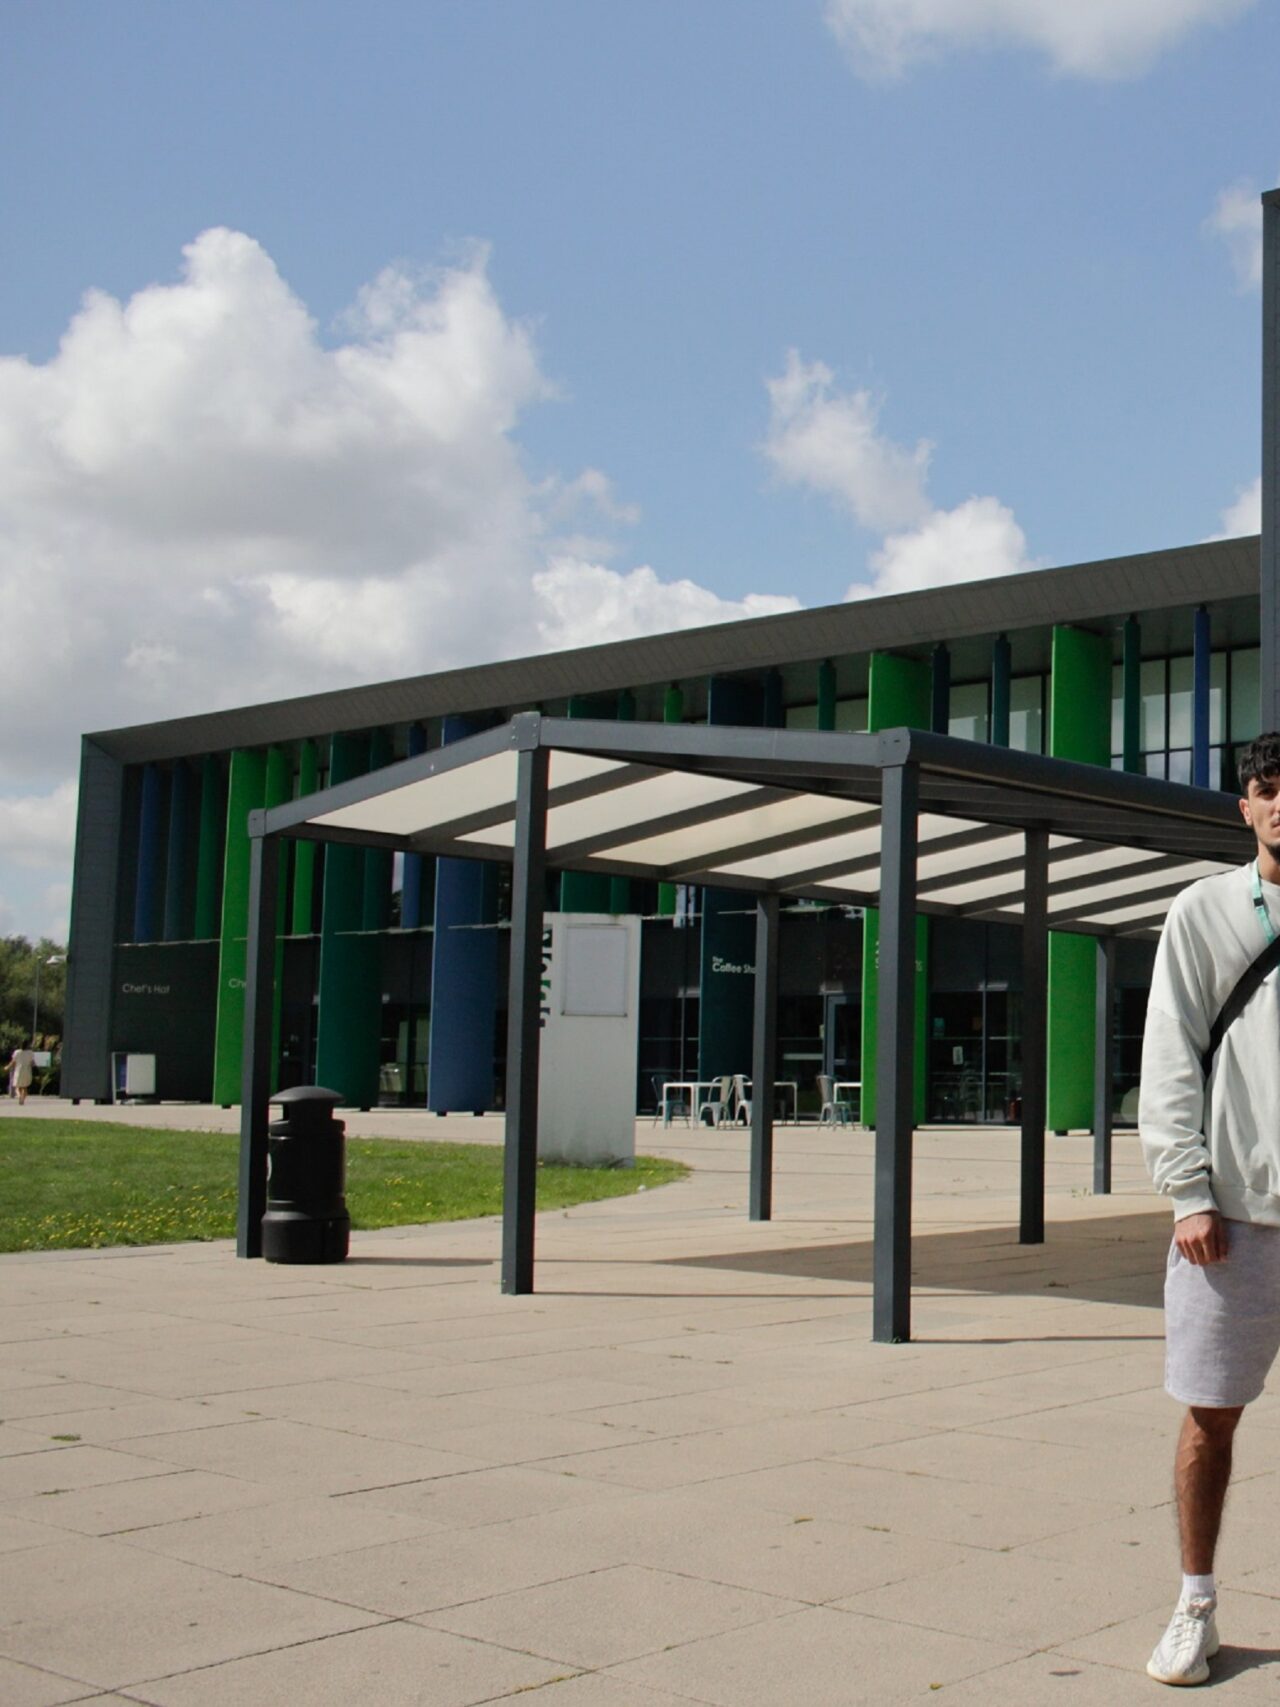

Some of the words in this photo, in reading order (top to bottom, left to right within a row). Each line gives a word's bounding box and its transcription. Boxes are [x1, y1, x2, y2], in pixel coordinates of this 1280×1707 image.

[712, 962, 742, 973] Coffee
[743, 964, 757, 974] Sho
[121, 983, 153, 993] Chef's
